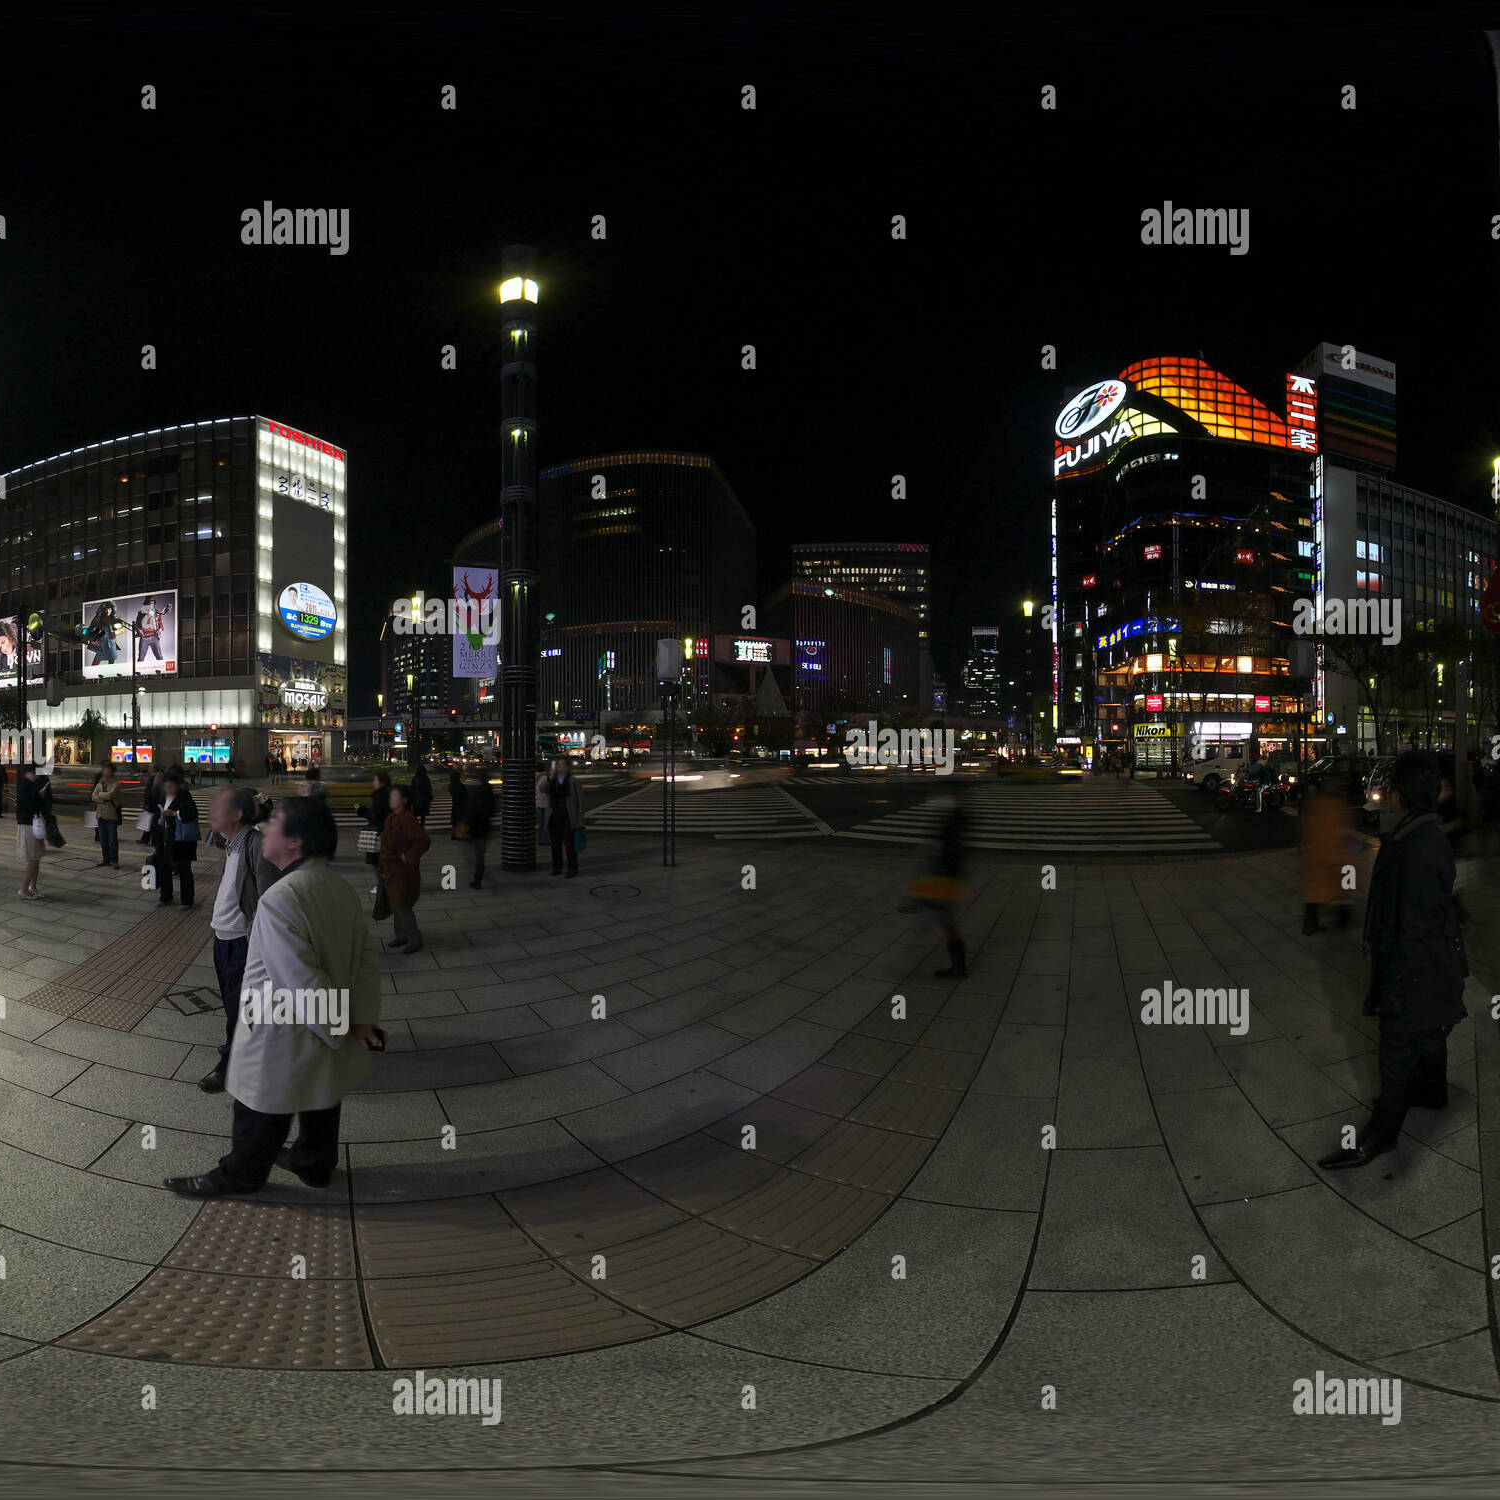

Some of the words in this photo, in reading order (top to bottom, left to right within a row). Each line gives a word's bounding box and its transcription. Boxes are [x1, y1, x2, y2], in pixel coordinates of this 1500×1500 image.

[1290, 375, 1316, 451] 不二家
[265, 420, 344, 462] TOSHIBA
[1054, 420, 1134, 477] FUJIYA
[300, 613, 319, 625] 1329
[284, 691, 326, 706] MOSAIC
[1136, 725, 1166, 737] Nikon
